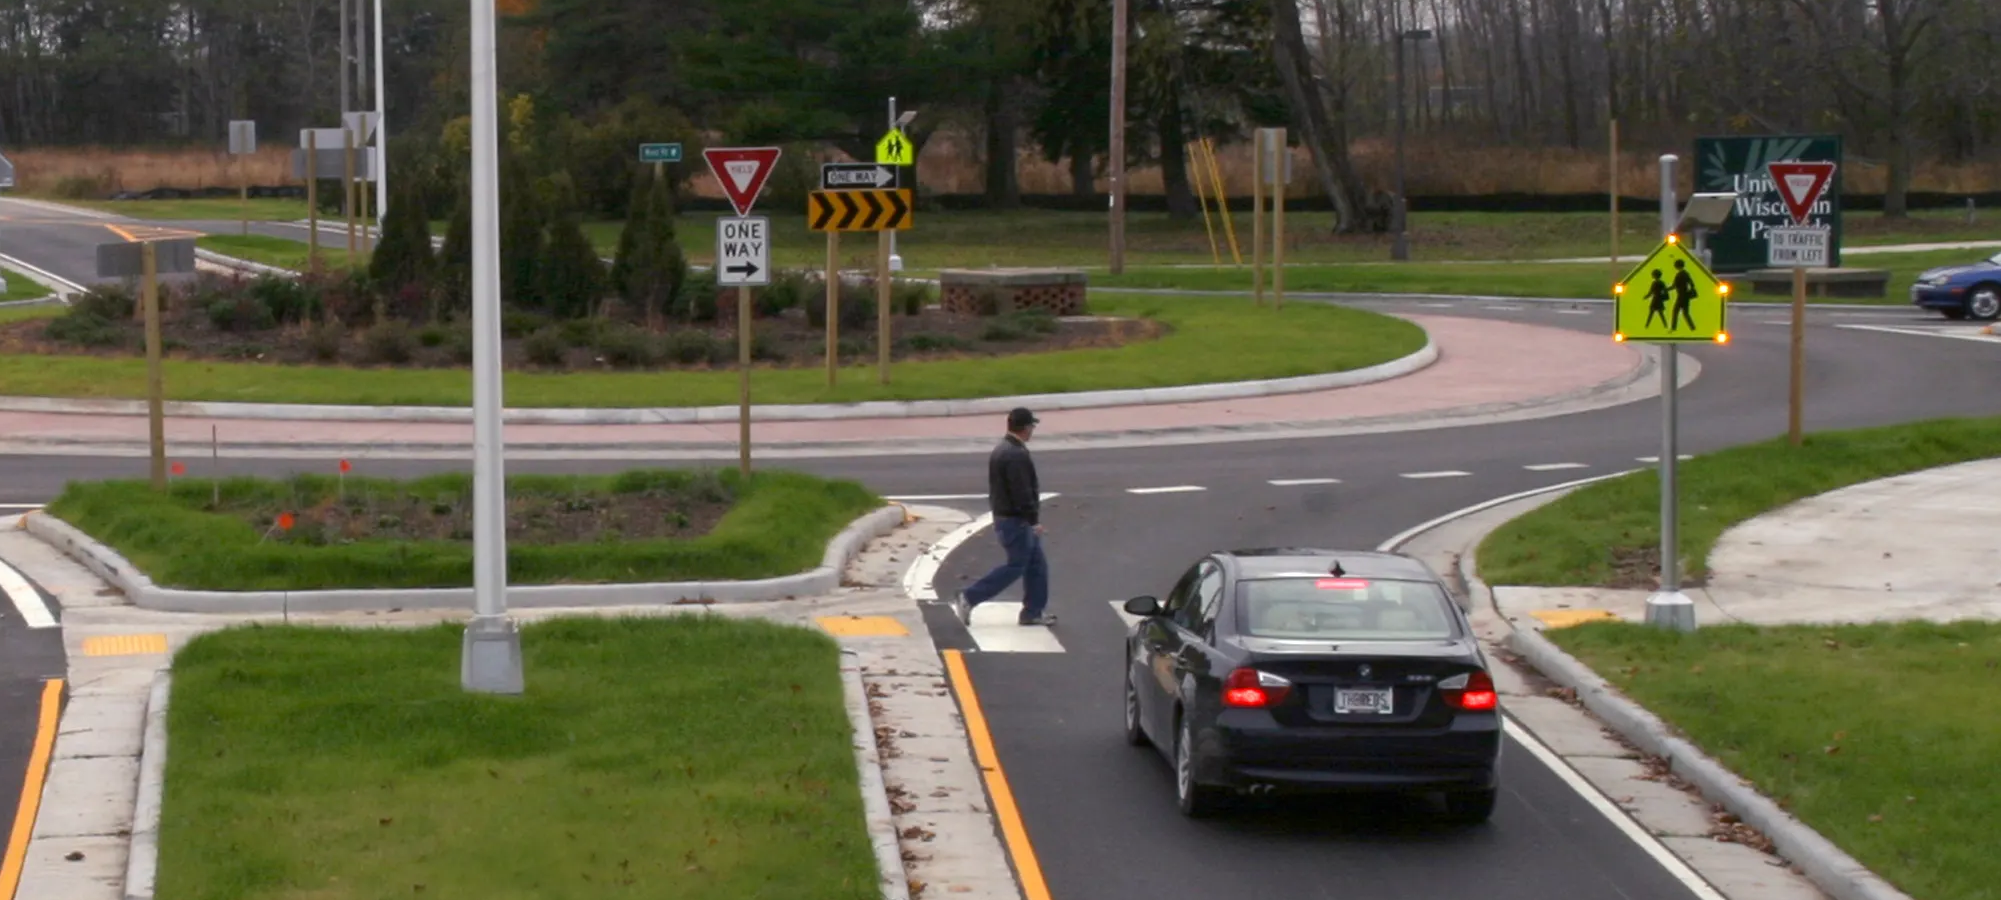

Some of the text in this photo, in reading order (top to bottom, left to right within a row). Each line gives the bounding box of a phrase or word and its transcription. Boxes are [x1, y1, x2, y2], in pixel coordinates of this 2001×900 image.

[731, 165, 753, 174] YIELD
[830, 171, 878, 182] ONE WAY
[725, 223, 761, 239] ONE
[1774, 233, 1824, 245] TO TRAFFIC
[724, 242, 762, 257] WAY
[1773, 249, 1823, 261] FROM LEFT
